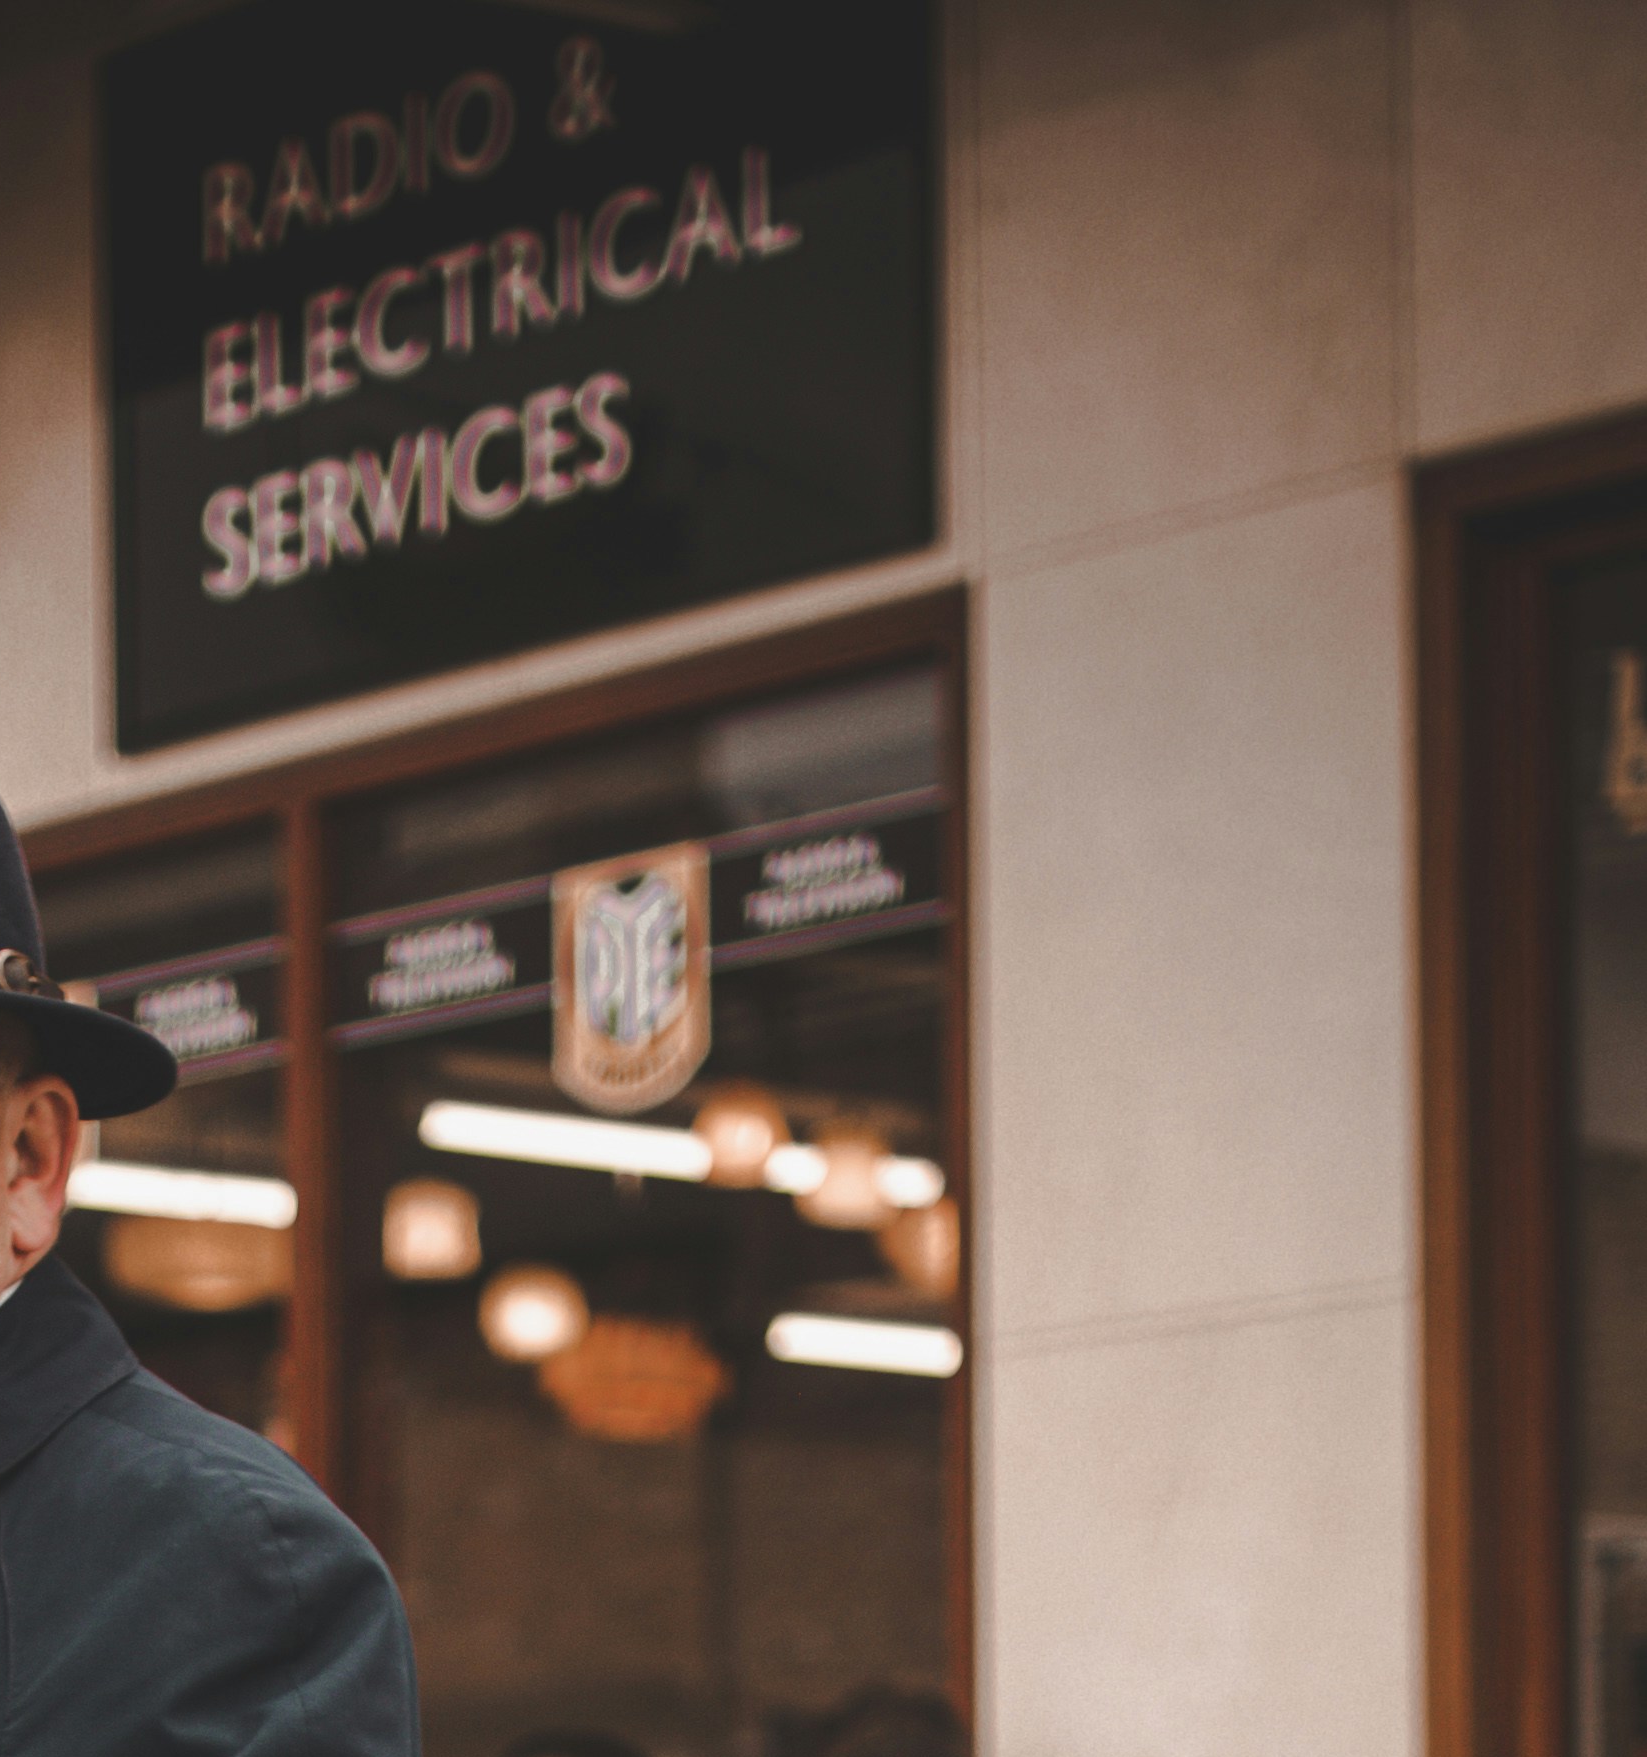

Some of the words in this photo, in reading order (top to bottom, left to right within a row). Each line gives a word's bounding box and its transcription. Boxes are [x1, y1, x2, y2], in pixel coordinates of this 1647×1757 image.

[203, 70, 515, 264] RADIO
[552, 36, 616, 139] &
[203, 147, 802, 431] ELECTRICAL
[203, 372, 632, 600] SERVICES
